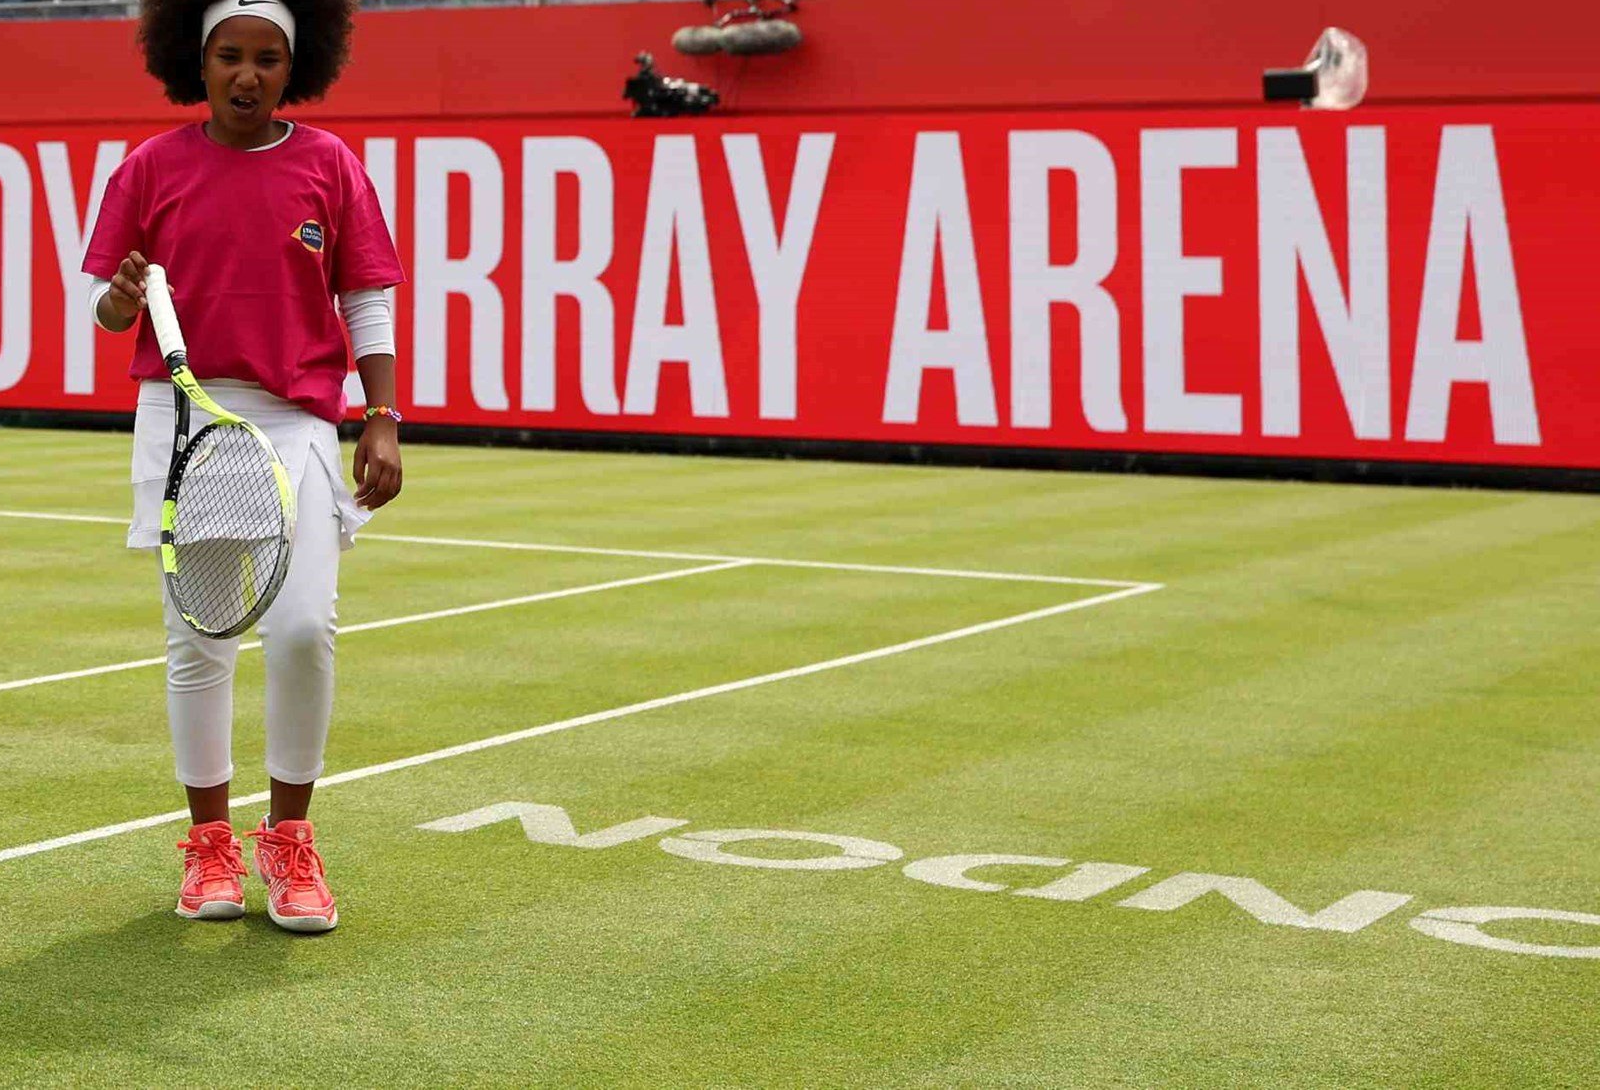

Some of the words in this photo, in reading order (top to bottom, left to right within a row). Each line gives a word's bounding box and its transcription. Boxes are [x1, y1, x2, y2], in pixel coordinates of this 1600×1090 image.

[364, 132, 837, 421] RRAY
[881, 123, 1543, 447] ARENA
[412, 799, 1600, 958] ONDON
